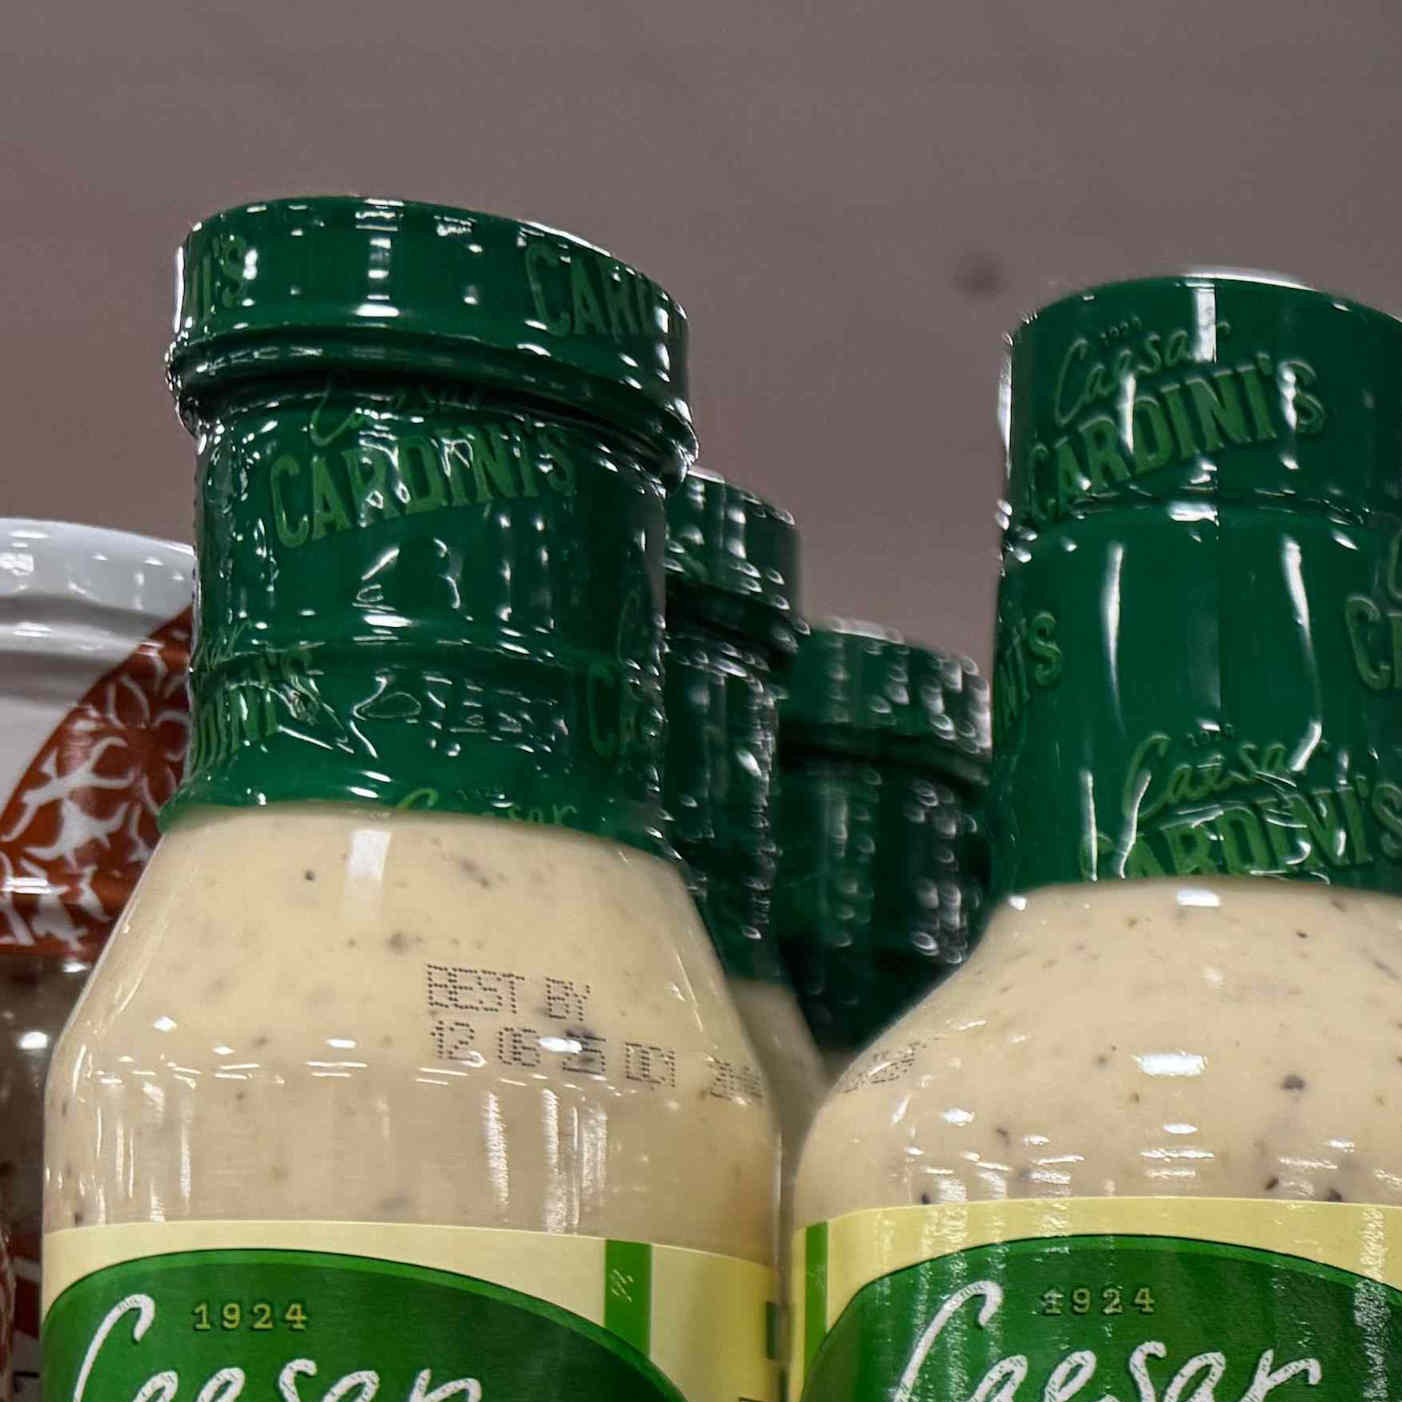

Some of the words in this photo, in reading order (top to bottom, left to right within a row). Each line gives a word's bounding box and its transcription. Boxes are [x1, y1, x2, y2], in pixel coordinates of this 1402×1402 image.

[426, 964, 525, 1014] BEST
[546, 977, 590, 1021] BY
[1039, 1286, 1155, 1316] 1924
[192, 1302, 310, 1331] 1924
